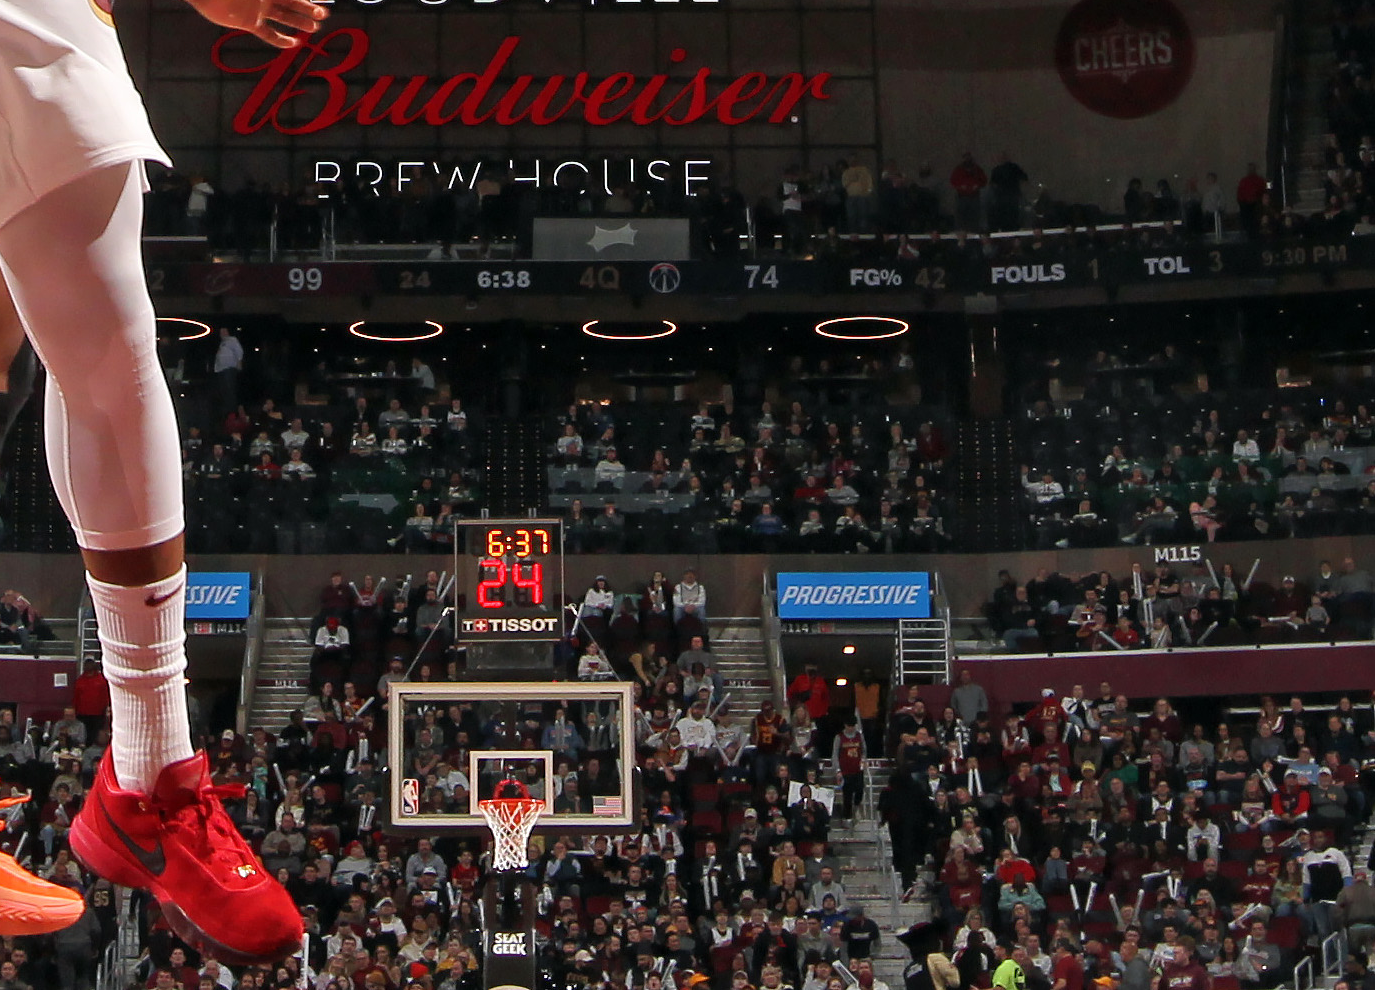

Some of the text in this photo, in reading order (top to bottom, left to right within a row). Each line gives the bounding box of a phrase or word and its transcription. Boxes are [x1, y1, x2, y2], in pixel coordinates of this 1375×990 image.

[1074, 30, 1173, 71] CHEERS
[211, 26, 831, 135] Budweiser
[289, 267, 323, 292] 99
[400, 270, 431, 290] 24
[477, 269, 531, 290] 6:38
[580, 267, 621, 292] 4Q
[744, 264, 780, 290] 74
[850, 269, 902, 288] FG%
[915, 266, 947, 290] 42
[991, 262, 1066, 284] FOULS
[1088, 258, 1100, 281] 1
[1144, 256, 1191, 276] TOL
[1209, 250, 1224, 272] 3
[1261, 246, 1307, 267] 9:30
[1312, 243, 1348, 265] PM
[486, 528, 551, 558] 6:37
[1154, 546, 1201, 563] M115
[476, 559, 543, 608] 24
[780, 583, 921, 607] PROGRESSIVE
[488, 618, 558, 632] TISSOT
[492, 944, 527, 956] GEEK
[494, 932, 526, 943] SEAT
